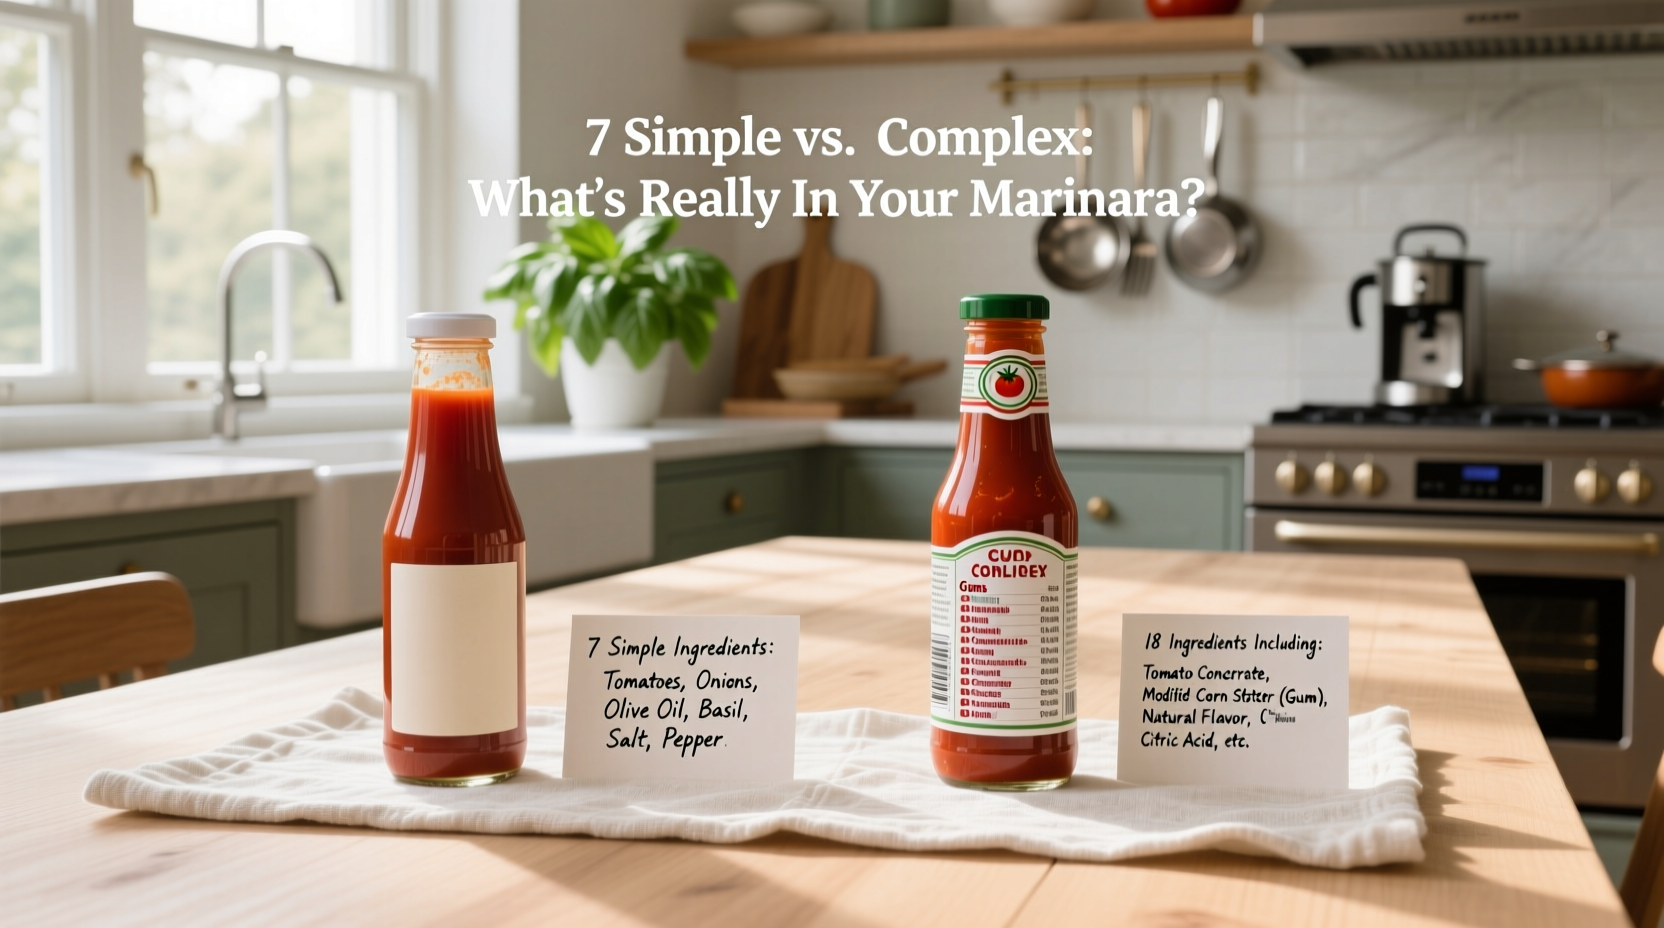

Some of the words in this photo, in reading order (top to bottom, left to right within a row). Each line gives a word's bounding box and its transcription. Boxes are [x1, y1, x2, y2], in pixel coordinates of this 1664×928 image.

[589, 637, 600, 658] 7
[608, 636, 665, 665] Simple
[674, 636, 773, 665] Ingredients:
[1146, 633, 1161, 650] 18
[1170, 633, 1246, 657] Ingredients
[1255, 633, 1322, 659] Including:
[604, 670, 685, 692] Tomatoes,
[697, 670, 757, 692] Onions,
[1143, 664, 1193, 680] Tomato
[1196, 688, 1227, 702] Corn
[1280, 686, 1327, 707] (Gum),
[604, 697, 649, 719] Olive
[657, 698, 688, 722] Oil,
[699, 698, 747, 722] Basil,
[1143, 709, 1196, 724] Natural
[1202, 709, 1250, 727] Flavor,
[606, 727, 650, 752] Salt,
[1141, 731, 1178, 747] Citric
[1183, 731, 1217, 751] Acid,
[1225, 733, 1249, 748] etc.
